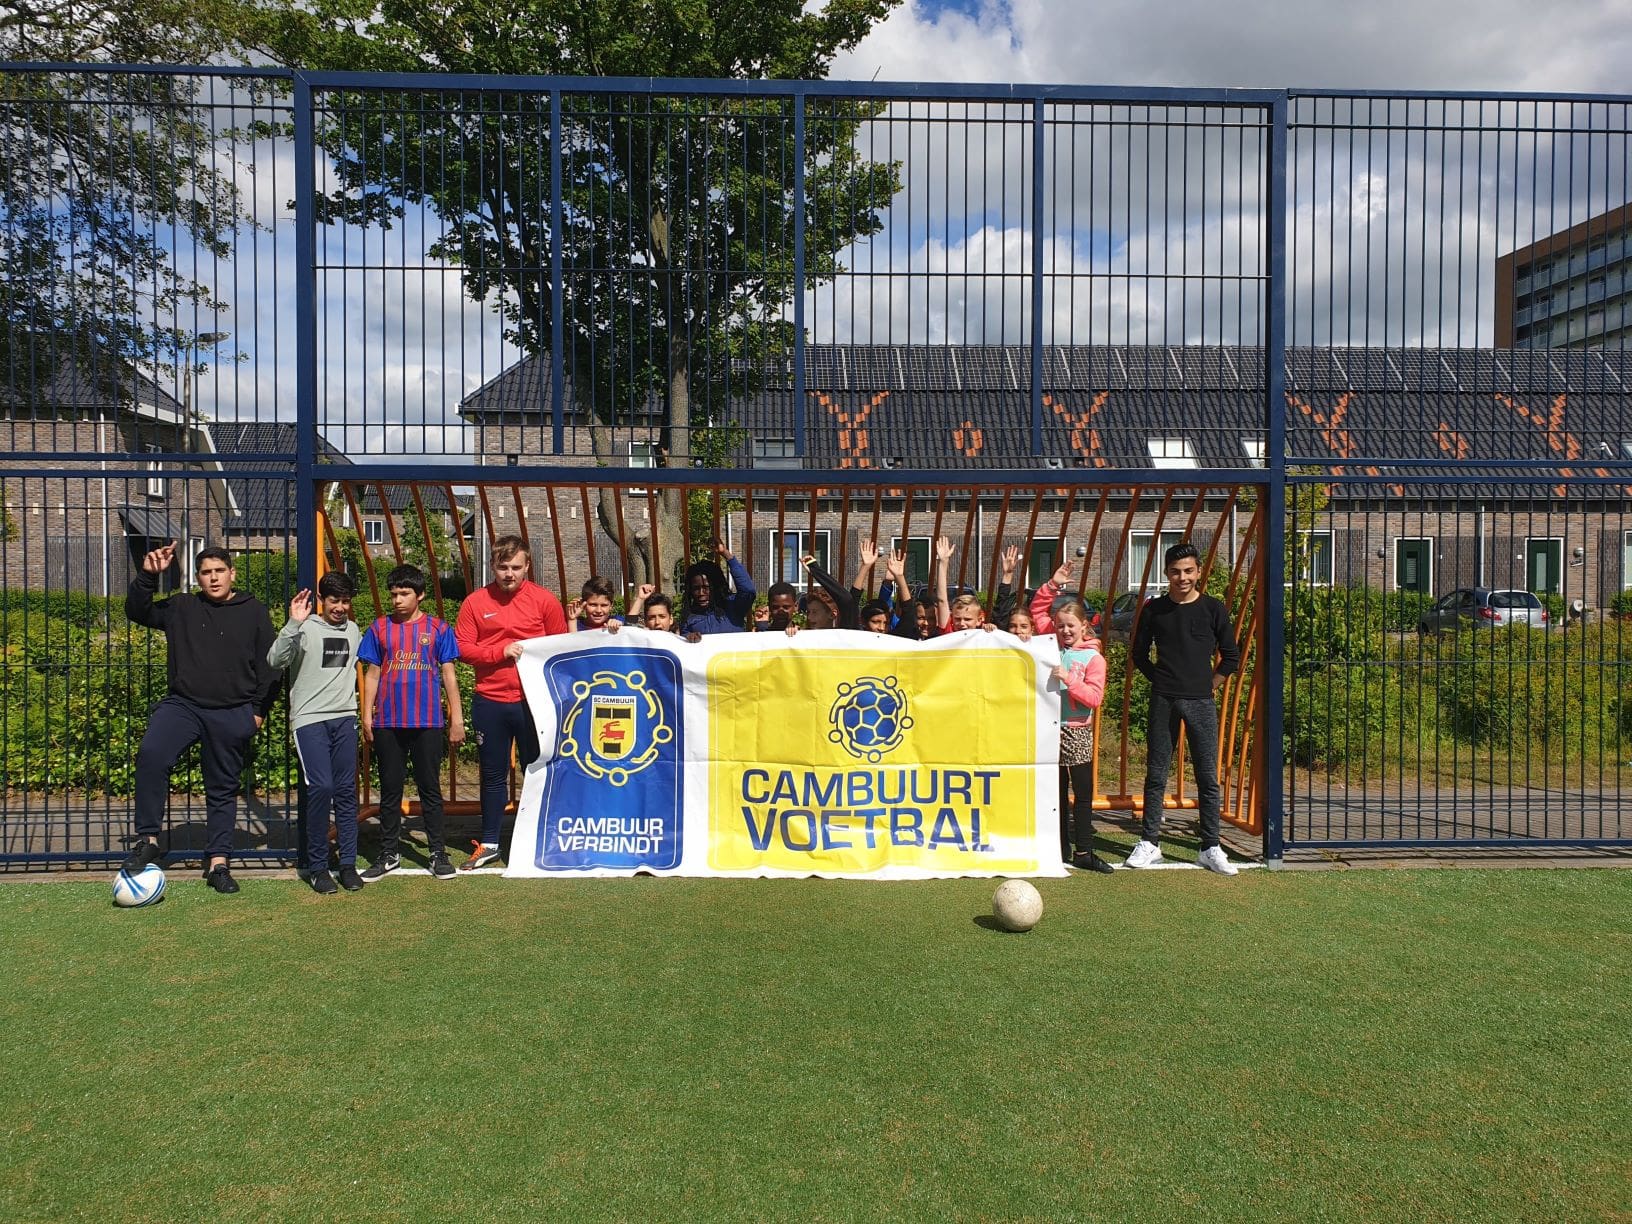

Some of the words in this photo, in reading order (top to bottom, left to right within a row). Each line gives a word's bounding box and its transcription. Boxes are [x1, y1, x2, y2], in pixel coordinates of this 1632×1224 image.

[395, 650, 421, 661] Qatar
[741, 768, 1000, 807] CAMBUURT
[558, 817, 664, 835] CAMBUUR
[741, 806, 995, 852] VOETBAL
[557, 836, 664, 854] VERBINDT
